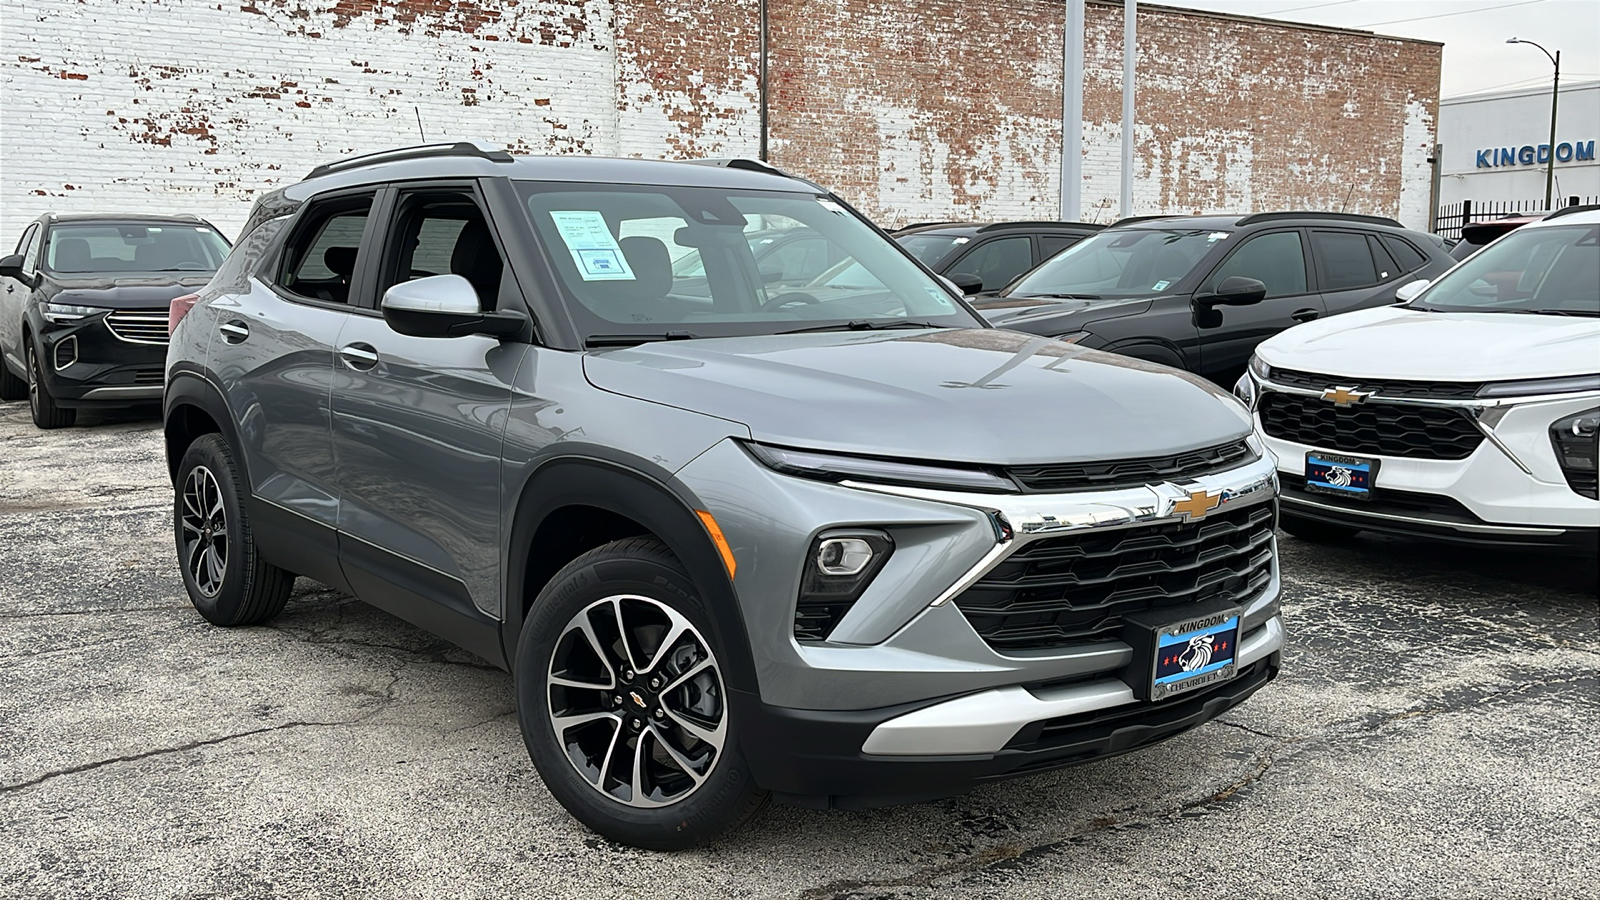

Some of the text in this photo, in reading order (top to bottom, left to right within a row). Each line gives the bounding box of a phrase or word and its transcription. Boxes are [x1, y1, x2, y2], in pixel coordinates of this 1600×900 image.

[1476, 140, 1595, 168] KINGDOM
[1320, 454, 1356, 464] KINGDOM
[1179, 614, 1225, 634] KINGDOM
[1170, 673, 1218, 693] CHEVROLET
